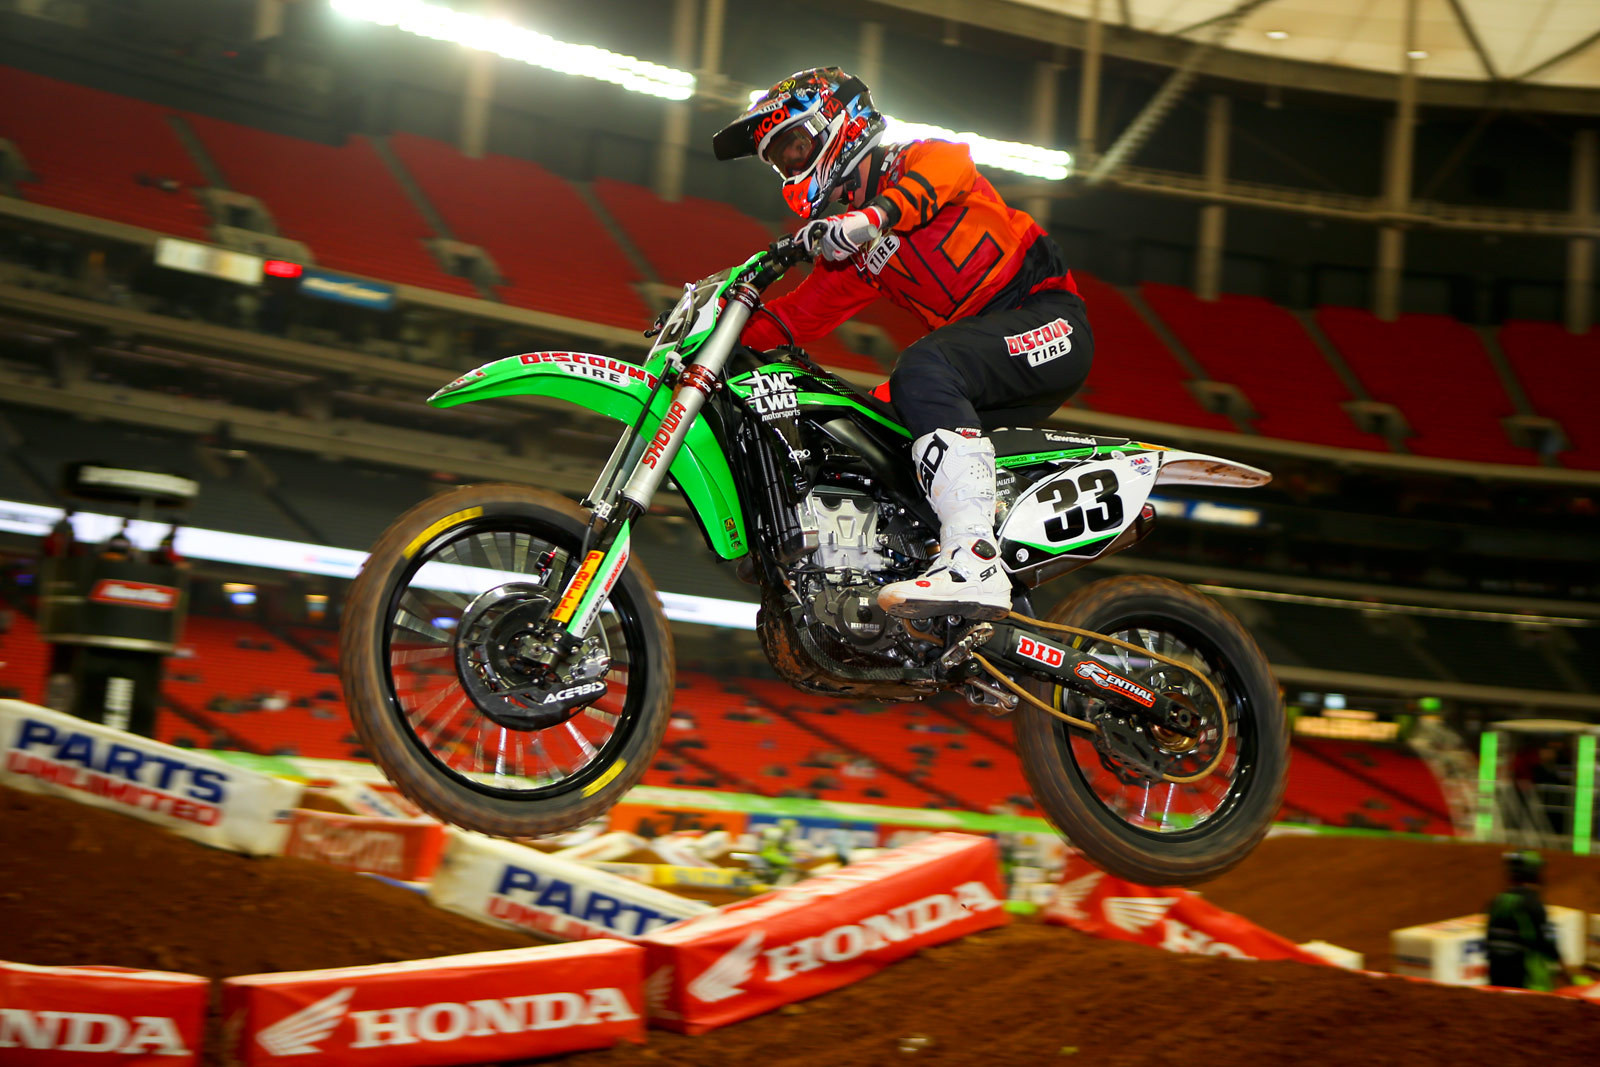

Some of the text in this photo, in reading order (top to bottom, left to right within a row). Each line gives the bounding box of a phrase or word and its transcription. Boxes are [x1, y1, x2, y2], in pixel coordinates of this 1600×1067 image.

[869, 236, 897, 270] TIRE
[565, 363, 622, 384] TIRE
[1031, 341, 1067, 363] TIRE
[641, 400, 688, 470] SHOWA
[761, 408, 801, 422] motorsports
[1044, 432, 1098, 446] Kawasaki
[1035, 468, 1125, 543] 33
[553, 552, 601, 619] PIRELLI
[543, 682, 606, 705] ACERBIS
[6, 750, 222, 828] UNLIMITED
[17, 717, 230, 805] PARTS
[764, 880, 1001, 982] HONDA
[350, 986, 641, 1049] HONDA
